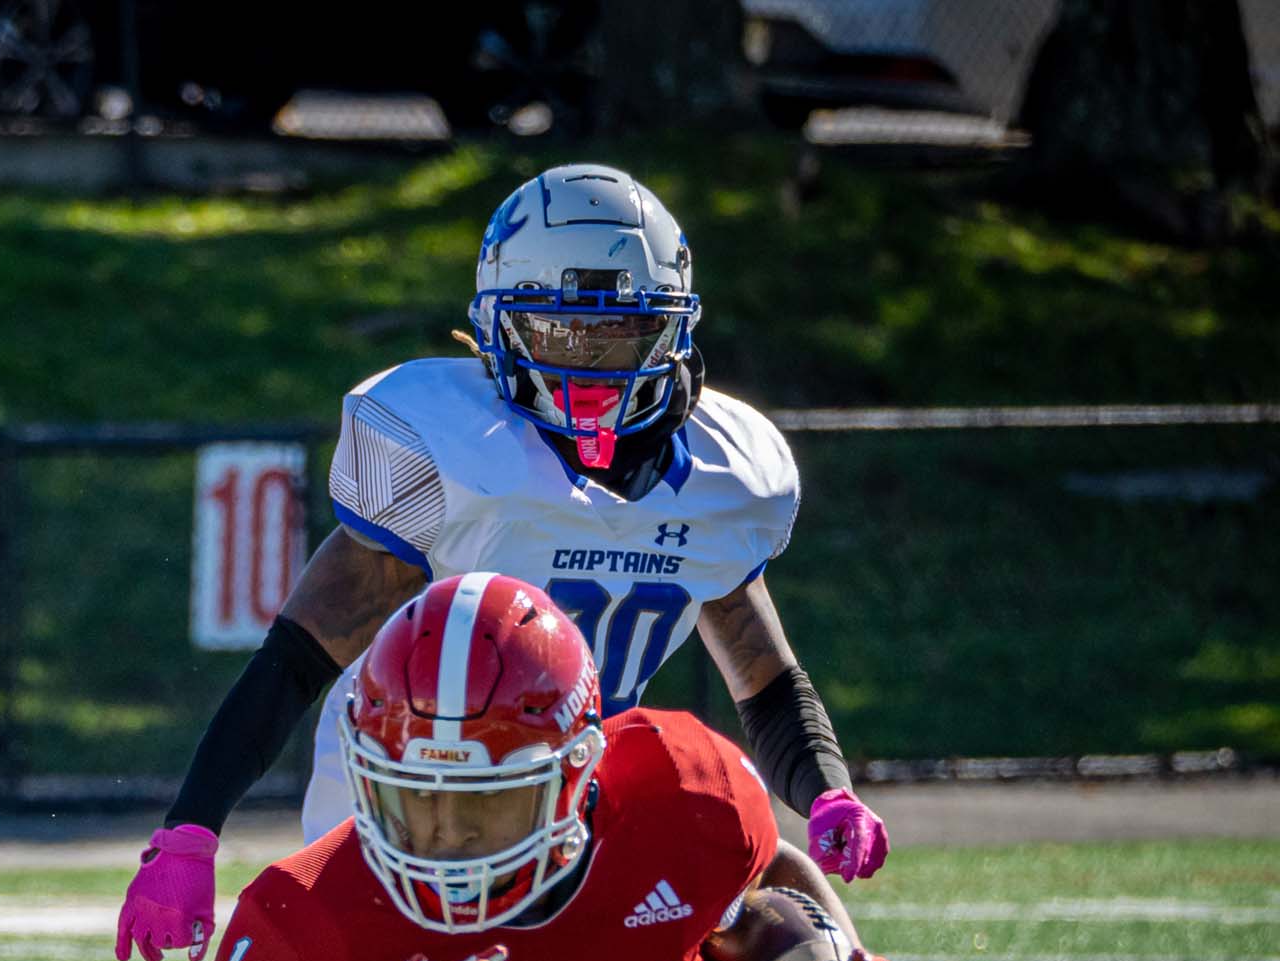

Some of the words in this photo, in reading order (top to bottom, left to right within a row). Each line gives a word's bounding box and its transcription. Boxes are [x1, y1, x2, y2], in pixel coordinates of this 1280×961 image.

[210, 466, 296, 625] 10
[552, 549, 686, 574] CAPTAINS
[419, 748, 471, 763] FAMILY
[623, 903, 694, 928] adidas
